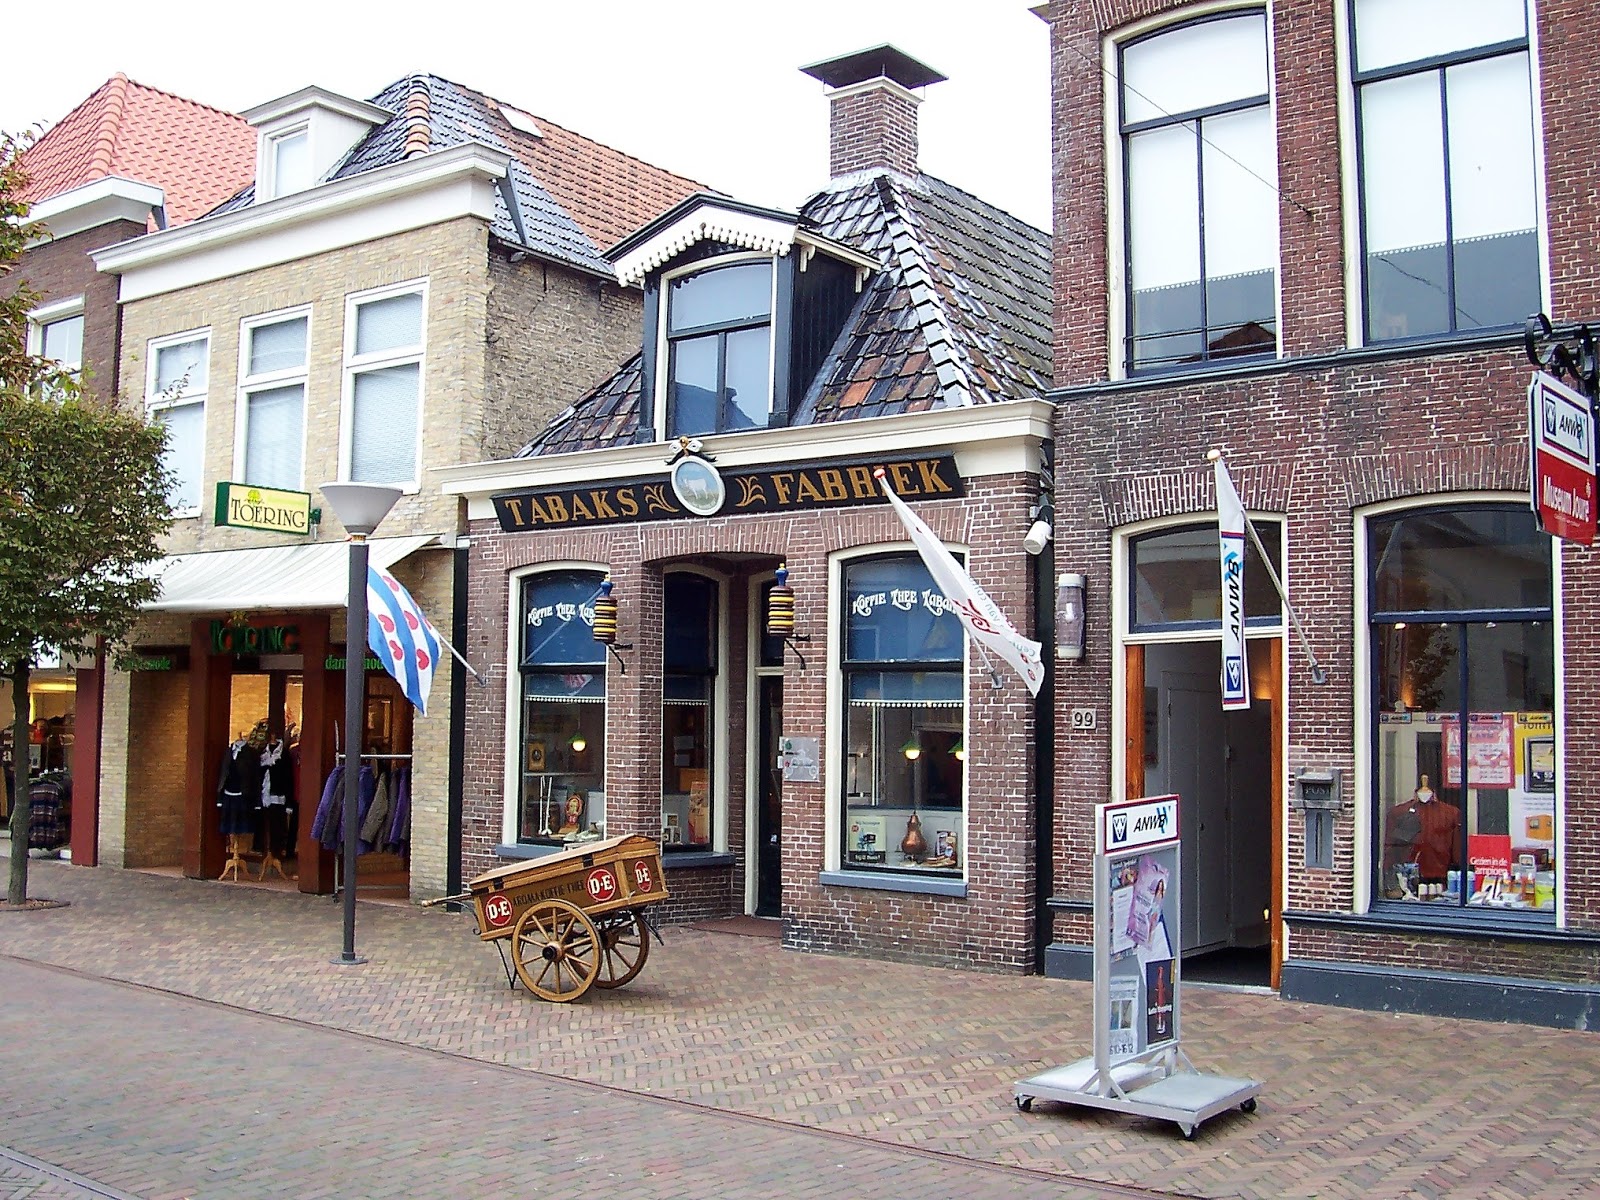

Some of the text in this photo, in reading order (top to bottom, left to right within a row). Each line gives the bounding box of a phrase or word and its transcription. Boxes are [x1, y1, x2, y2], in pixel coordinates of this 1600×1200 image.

[1559, 413, 1583, 440] ANWB
[504, 460, 953, 526] TABAKS FABREK
[1543, 474, 1572, 516] Museum
[230, 498, 306, 529] TOERING
[1228, 558, 1241, 642] ANWB
[1074, 711, 1093, 727] 99
[1133, 813, 1167, 833] ANWB
